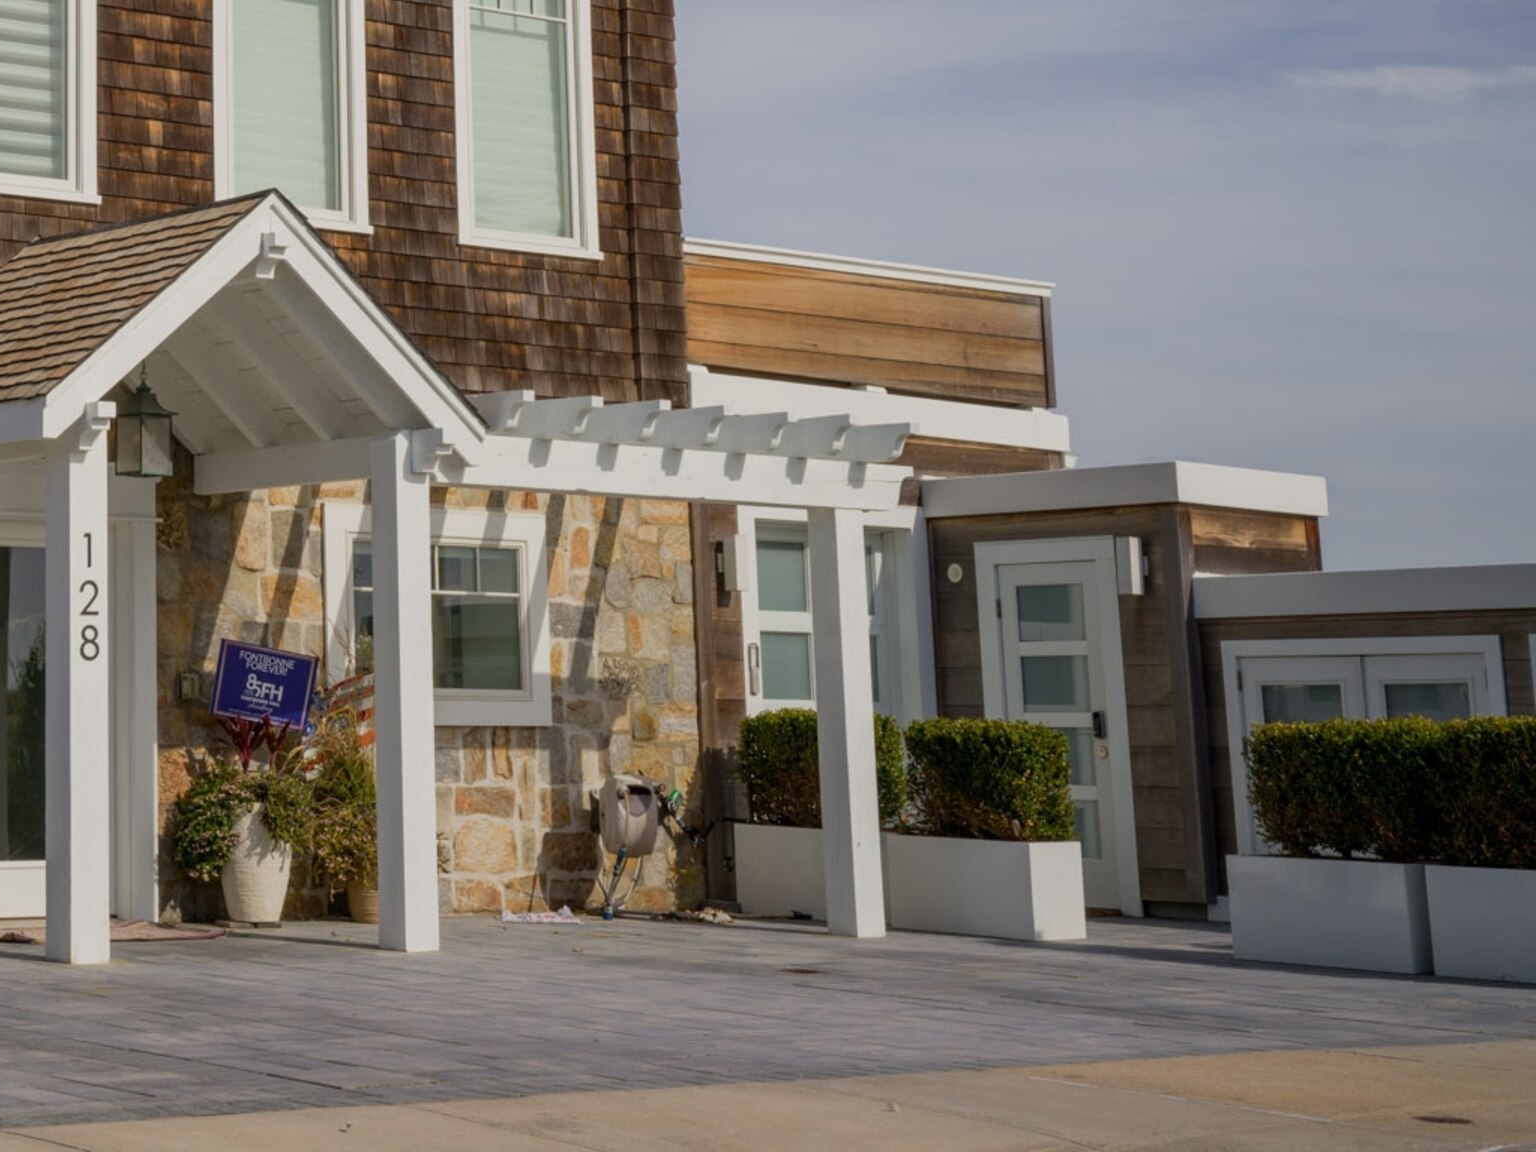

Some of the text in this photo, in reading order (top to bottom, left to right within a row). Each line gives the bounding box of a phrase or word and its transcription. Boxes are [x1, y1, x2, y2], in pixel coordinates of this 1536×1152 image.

[79, 532, 100, 661] 128
[239, 650, 295, 669] FONTBONNE
[246, 662, 288, 677] FOREVER!
